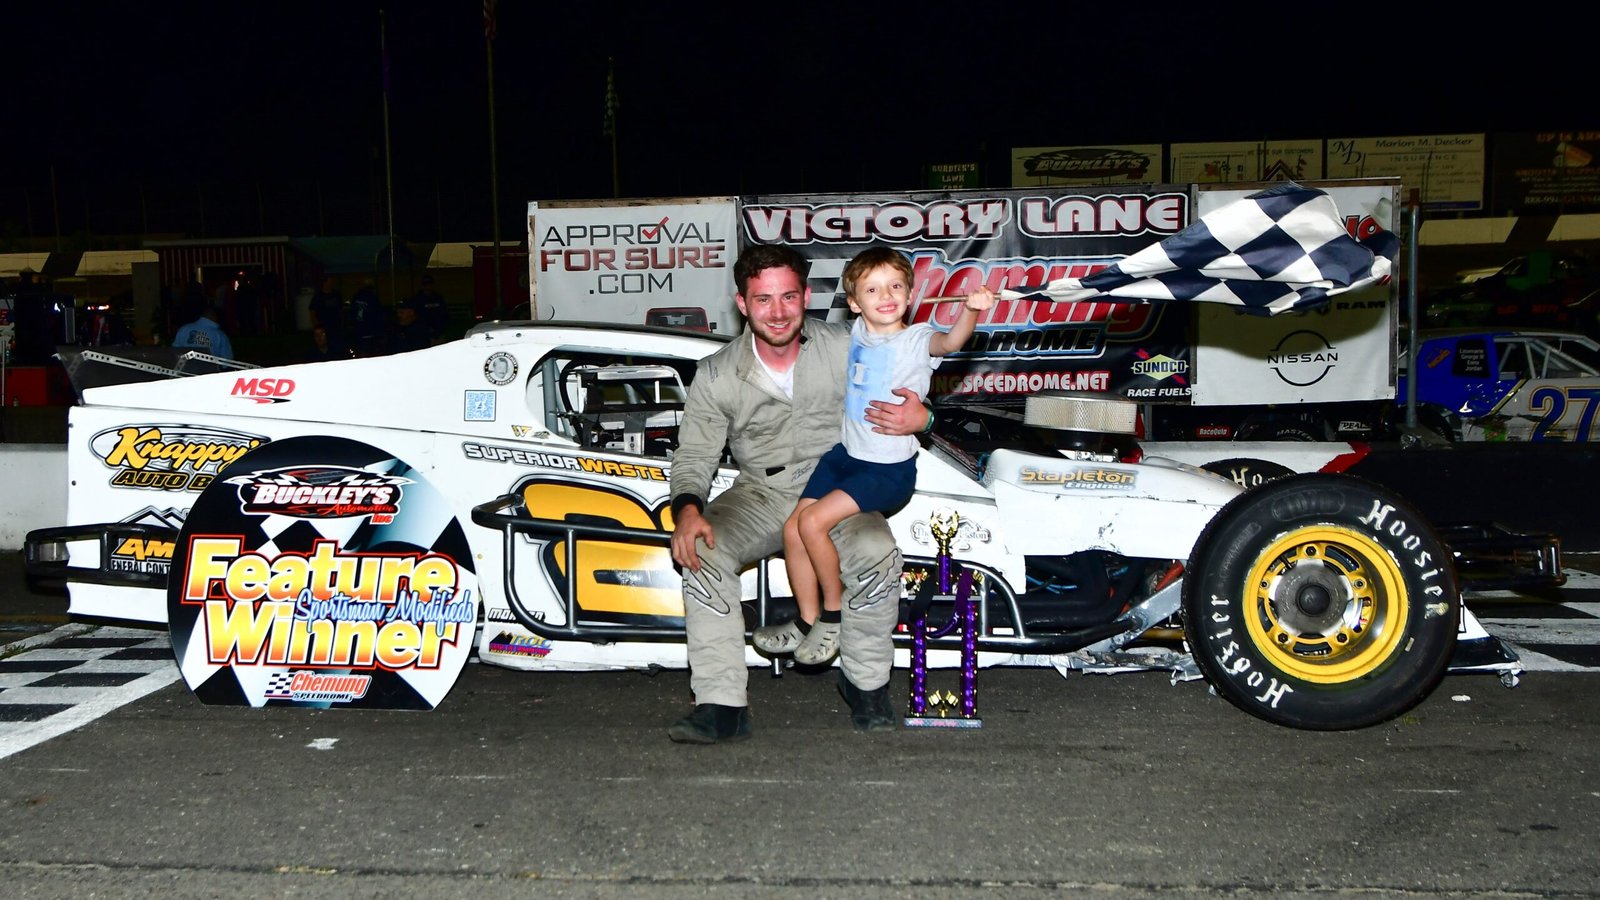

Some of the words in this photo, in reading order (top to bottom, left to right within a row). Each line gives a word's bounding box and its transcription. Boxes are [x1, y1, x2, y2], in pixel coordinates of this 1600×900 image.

[1035, 157, 1144, 171] BUCKLEY'S
[745, 200, 1007, 241] VICTORY
[1025, 197, 1181, 234] LANE
[541, 218, 726, 247] APPROVAL
[541, 248, 617, 273] FOR
[624, 246, 726, 270] SURE
[589, 272, 673, 295] .COM
[1336, 300, 1386, 310] RAM
[1134, 361, 1186, 374] SUNOCO
[1267, 353, 1339, 364] NISSAN
[231, 377, 296, 397] MSD
[1126, 388, 1157, 397] RACE
[1158, 387, 1192, 397] FUELS
[1529, 385, 1600, 442] 27
[105, 427, 261, 474] Knappy'
[113, 470, 189, 487] AUTO
[1020, 467, 1135, 484] Stapleton
[251, 484, 394, 505] BUCKLEY'S
[183, 535, 458, 604] Feature
[1358, 499, 1451, 621] Hoosier
[293, 588, 385, 634] Sportsman
[386, 588, 474, 637] Modifieds
[203, 600, 458, 670] Winner
[1208, 593, 1296, 710] Hoosier
[290, 673, 369, 696] Chemung
[293, 692, 354, 701] SPEEDROME
